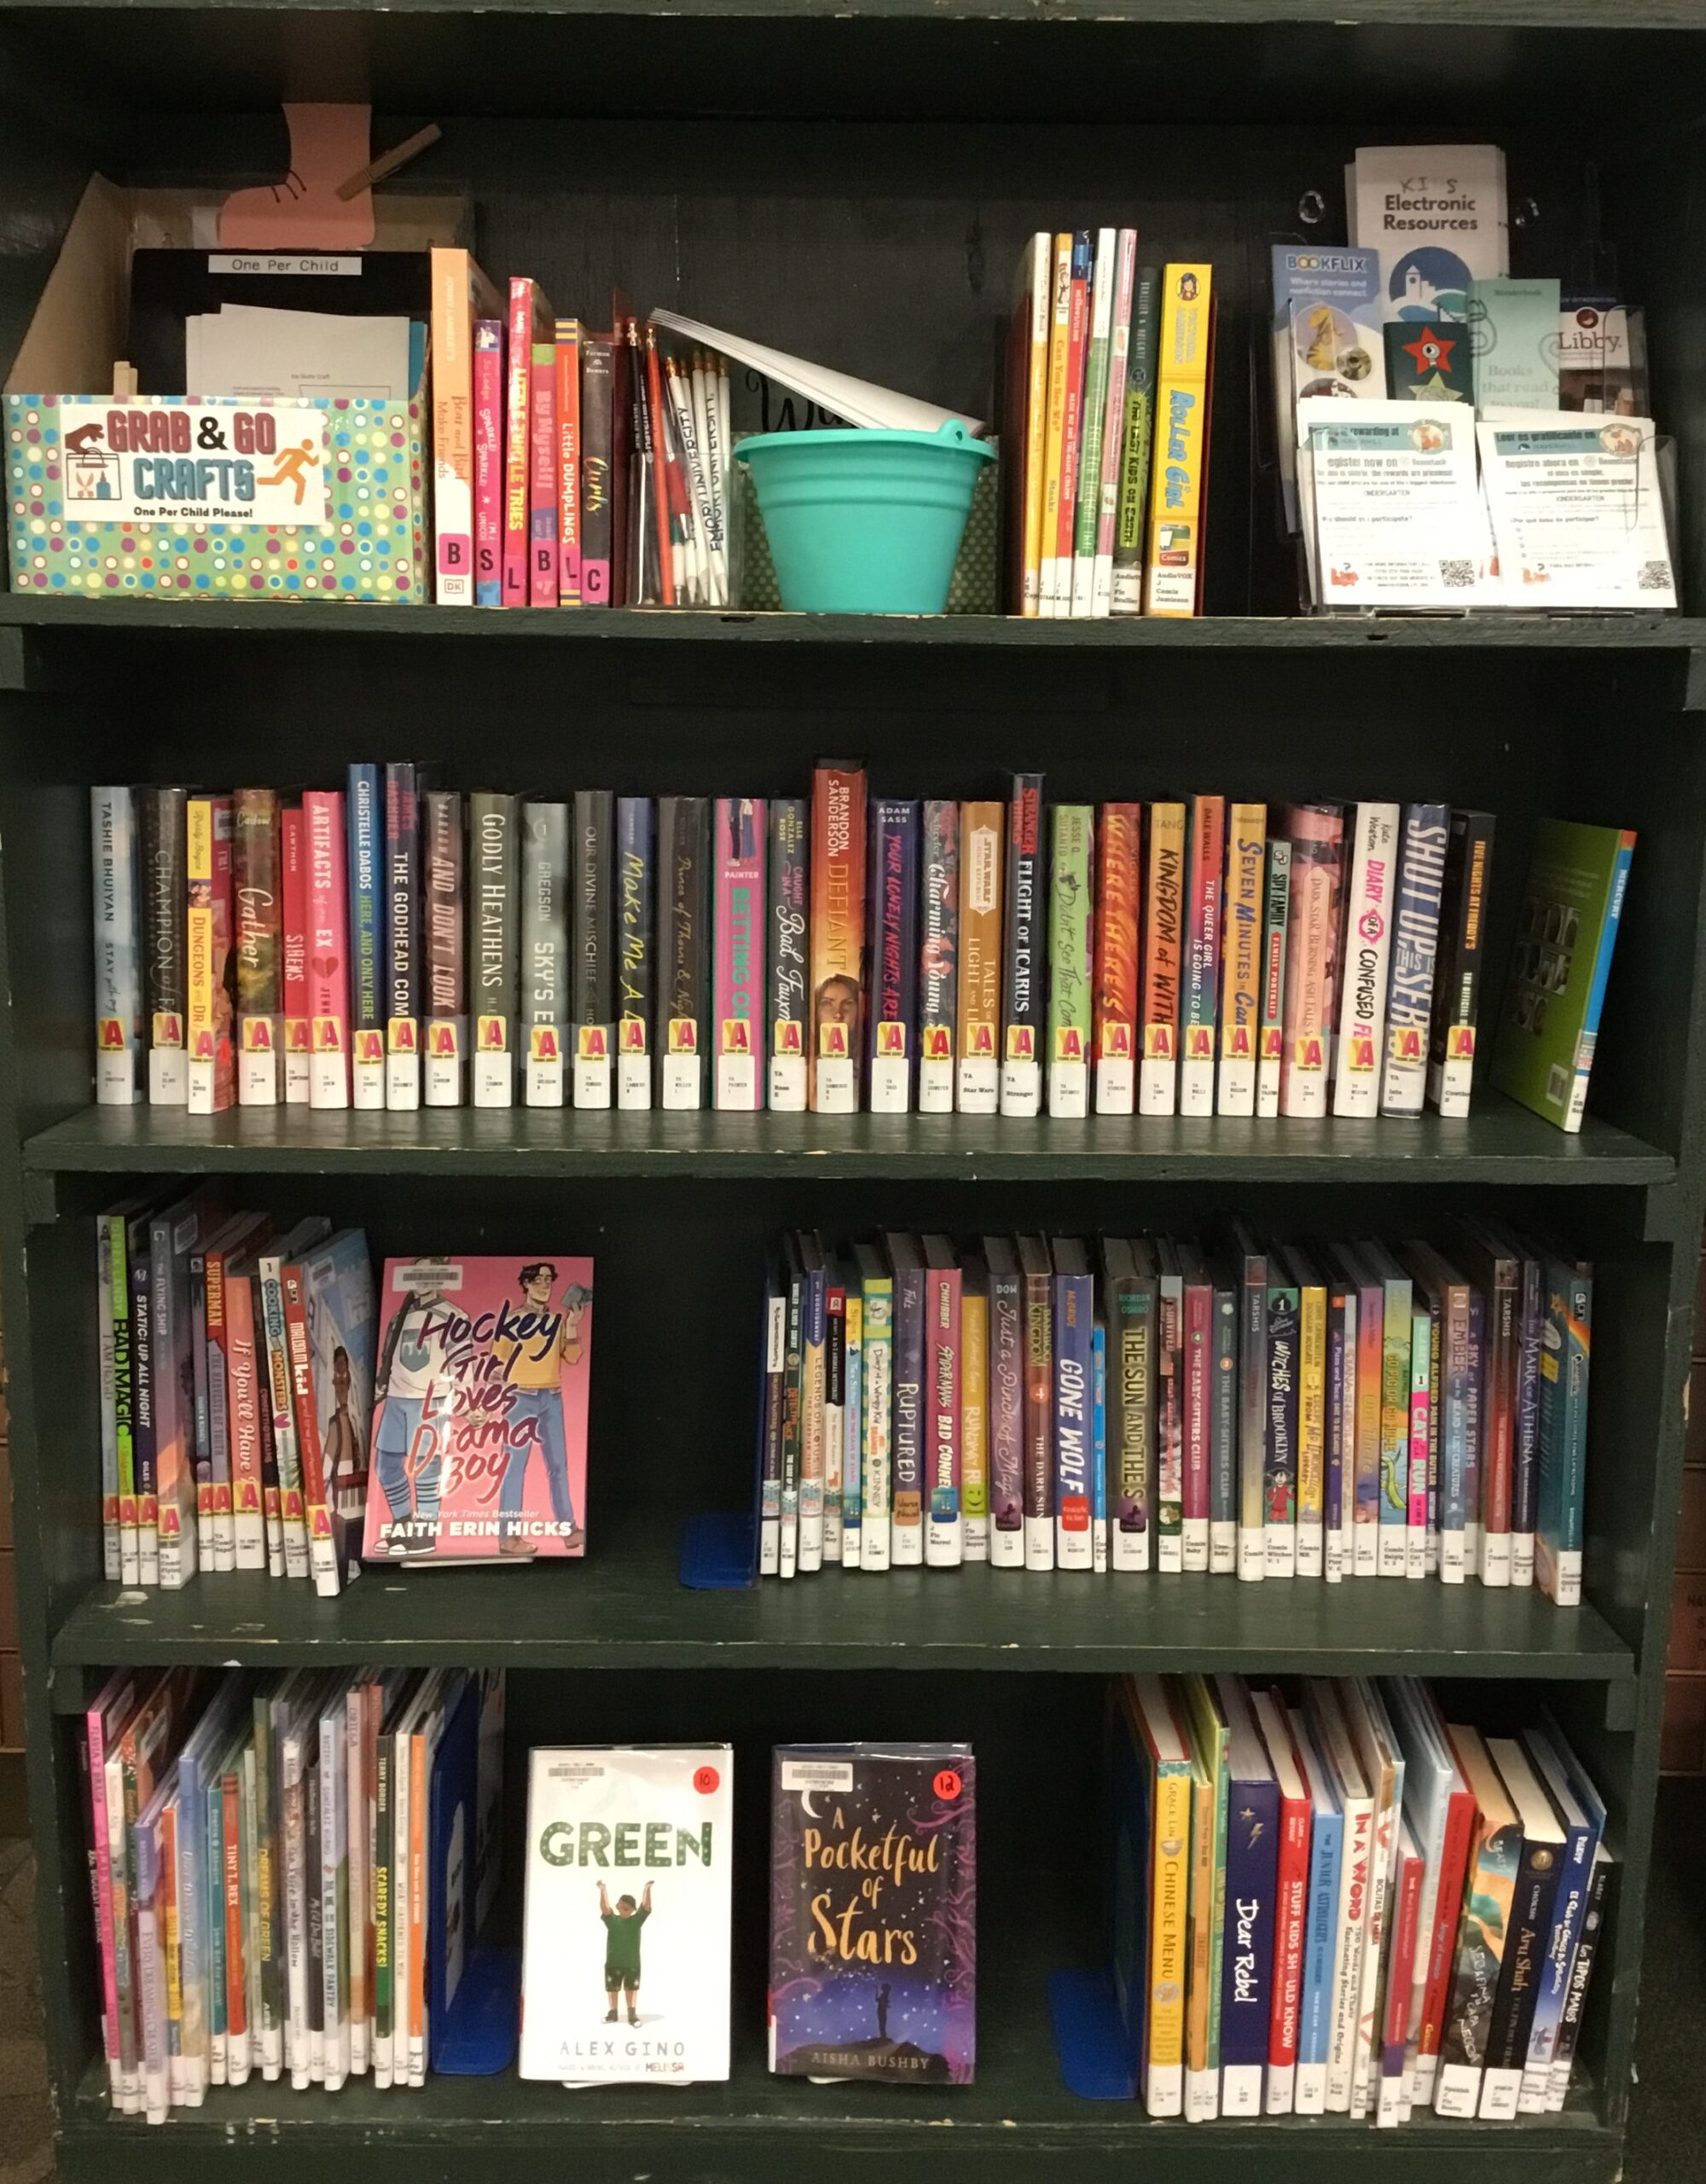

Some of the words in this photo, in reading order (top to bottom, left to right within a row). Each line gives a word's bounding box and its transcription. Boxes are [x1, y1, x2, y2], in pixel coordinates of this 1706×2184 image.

[1384, 215, 1478, 230] Resources
[1385, 195, 1476, 212] Electronic
[232, 259, 259, 271] One
[268, 259, 293, 271] Per
[300, 258, 339, 272] Child
[1286, 254, 1367, 273] BOOKFLIX
[1053, 340, 1065, 362] Can
[1488, 364, 1533, 376] Books
[1053, 364, 1065, 384] You
[1483, 381, 1512, 392] that
[1517, 381, 1548, 392] read
[438, 401, 448, 433] Make
[533, 391, 551, 413] By
[107, 410, 191, 453] GRAB
[197, 416, 229, 450] &
[233, 412, 277, 455] GO
[479, 409, 496, 451] SPARKLE!
[562, 423, 574, 458] Little
[1169, 390, 1195, 461] ROLLER
[438, 437, 448, 479] Friends
[478, 444, 488, 486] SPARKLE!
[534, 418, 554, 488] Myself!
[133, 457, 256, 502] CRAFTS
[583, 457, 608, 512] Curls
[134, 507, 154, 516] One
[157, 507, 177, 517] Per
[181, 507, 209, 518] Child
[212, 508, 253, 518] Please!
[562, 463, 575, 544] DUMPLINGS
[448, 543, 460, 565] B
[480, 549, 493, 571] S
[538, 549, 551, 572] B
[508, 568, 519, 589] L
[587, 569, 601, 591] C
[102, 802, 113, 852] TASHIE
[357, 781, 370, 847] CHRISTELLE
[828, 780, 838, 857] SANDERSON
[838, 787, 849, 850] BRANDON
[1023, 787, 1037, 853] STRANGER
[481, 814, 506, 874] GODLY
[584, 827, 596, 858] OUR
[1367, 816, 1381, 851] Weston
[358, 851, 371, 889] DABOS
[394, 852, 409, 885] THE
[432, 857, 453, 892] AND
[584, 863, 596, 911] DIVINE
[622, 851, 644, 923] Make
[102, 859, 114, 921] BHUIYAN
[538, 862, 551, 921] GREGSON
[1018, 861, 1032, 921] FLIGHT
[1204, 880, 1216, 901] THE
[1610, 869, 1628, 920] MERCURY
[238, 888, 274, 968] Gather
[359, 895, 371, 927] HERE,
[432, 903, 454, 955] DON'T
[827, 863, 848, 970] DEFIANT
[1203, 905, 1214, 940] QUEER
[360, 930, 372, 955] AND
[394, 892, 409, 972] GODHEAD
[481, 885, 505, 987] HEATHENS
[584, 917, 596, 983] MISCHIEF
[1018, 926, 1029, 944] OF
[105, 943, 114, 973] STAY
[285, 934, 304, 981] SIRENS
[624, 933, 644, 971] Me
[1203, 944, 1214, 968] GIRL
[361, 959, 373, 987] ONLY
[432, 965, 454, 1008] LOOK
[620, 975, 642, 1000] A
[983, 959, 995, 1008] TALES
[1015, 949, 1030, 1012] ICARUS
[362, 991, 373, 1020] HERE
[157, 1277, 166, 1310] FLYING
[206, 1261, 222, 1327] SUPERMAN
[265, 1280, 281, 1336] COOKING
[939, 1282, 950, 1328] CHHIBBER
[136, 1294, 148, 1340] STATIC:
[157, 1312, 166, 1335] SHIP
[416, 1299, 562, 1362] Hockey
[1251, 1294, 1260, 1332] TARSHIS
[113, 1319, 130, 1362] BAD
[138, 1343, 149, 1360] UP
[1123, 1327, 1146, 1362] THE
[138, 1363, 149, 1385] ALL
[440, 1342, 520, 1382] Girl
[1523, 1337, 1540, 1385] MARK
[271, 1350, 287, 1411] MONSTERS
[1059, 1359, 1083, 1418] GONE
[1123, 1368, 1146, 1405] SUN
[114, 1368, 131, 1436] MAGIC
[138, 1388, 150, 1427] NIGHT
[897, 1383, 919, 1482] RUPTURED
[1126, 1412, 1144, 1443] AND
[1412, 1407, 1427, 1441] CAT
[1522, 1398, 1537, 1464] ATHENA
[1059, 1426, 1084, 1493] WOLF
[1124, 1448, 1145, 1483] THE
[1412, 1459, 1427, 1495] RUN
[873, 1470, 882, 1507] KINNEY
[380, 1522, 442, 1537] FAITH
[450, 1521, 500, 1536] ERIN
[507, 1521, 572, 1536] HICKS
[699, 1773, 711, 1786] 10
[1168, 1782, 1178, 1815] GRACE
[833, 1807, 845, 1829] A
[1168, 1818, 1177, 1837] LIN
[1354, 1812, 1372, 1831] IN
[539, 1821, 712, 1867] GREEN
[804, 1824, 939, 1887] Pocketful
[1355, 1839, 1367, 1853] A
[1572, 1836, 1587, 1863] PILKEY
[258, 1849, 270, 1898] DREAMS
[375, 1866, 388, 1918] SCAREDY
[1348, 1861, 1368, 1920] WORD
[259, 1901, 270, 1917] OF
[862, 1876, 884, 1910] of
[1162, 1862, 1179, 1929] CHINESE
[1289, 1881, 1303, 1917] STUFF
[259, 1921, 270, 1961] GREEN
[808, 1893, 918, 1966] Stars
[1234, 1899, 1258, 1947] Dear
[1287, 1920, 1300, 1949] KIDS
[1517, 1928, 1535, 1955] Aru
[374, 1921, 388, 1967] SNACKS!
[1161, 1933, 1176, 1978] MENU
[1233, 1953, 1258, 2002] Rebel
[1283, 1953, 1298, 2002] SHOULD
[1512, 1957, 1531, 1992] Shah
[1281, 2007, 1295, 2048] KNOW
[560, 2041, 614, 2056] ALEX
[624, 2042, 685, 2056] GINO
[811, 2053, 861, 2066] AISHA
[868, 2053, 930, 2070] BUSHBY
